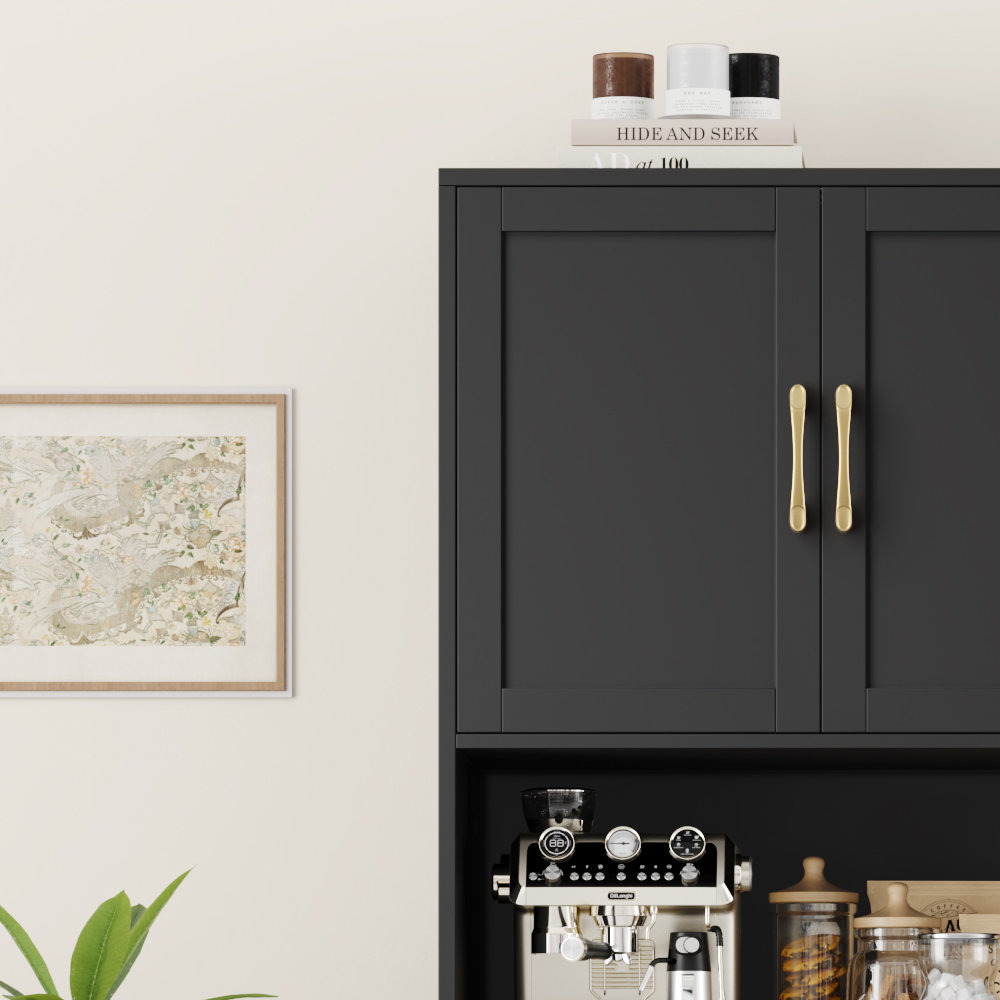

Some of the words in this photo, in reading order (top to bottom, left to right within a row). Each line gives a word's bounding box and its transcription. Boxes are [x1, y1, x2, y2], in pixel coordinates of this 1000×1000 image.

[616, 127, 663, 141] HIDE
[667, 127, 705, 141] AND
[710, 127, 759, 141] SEEK
